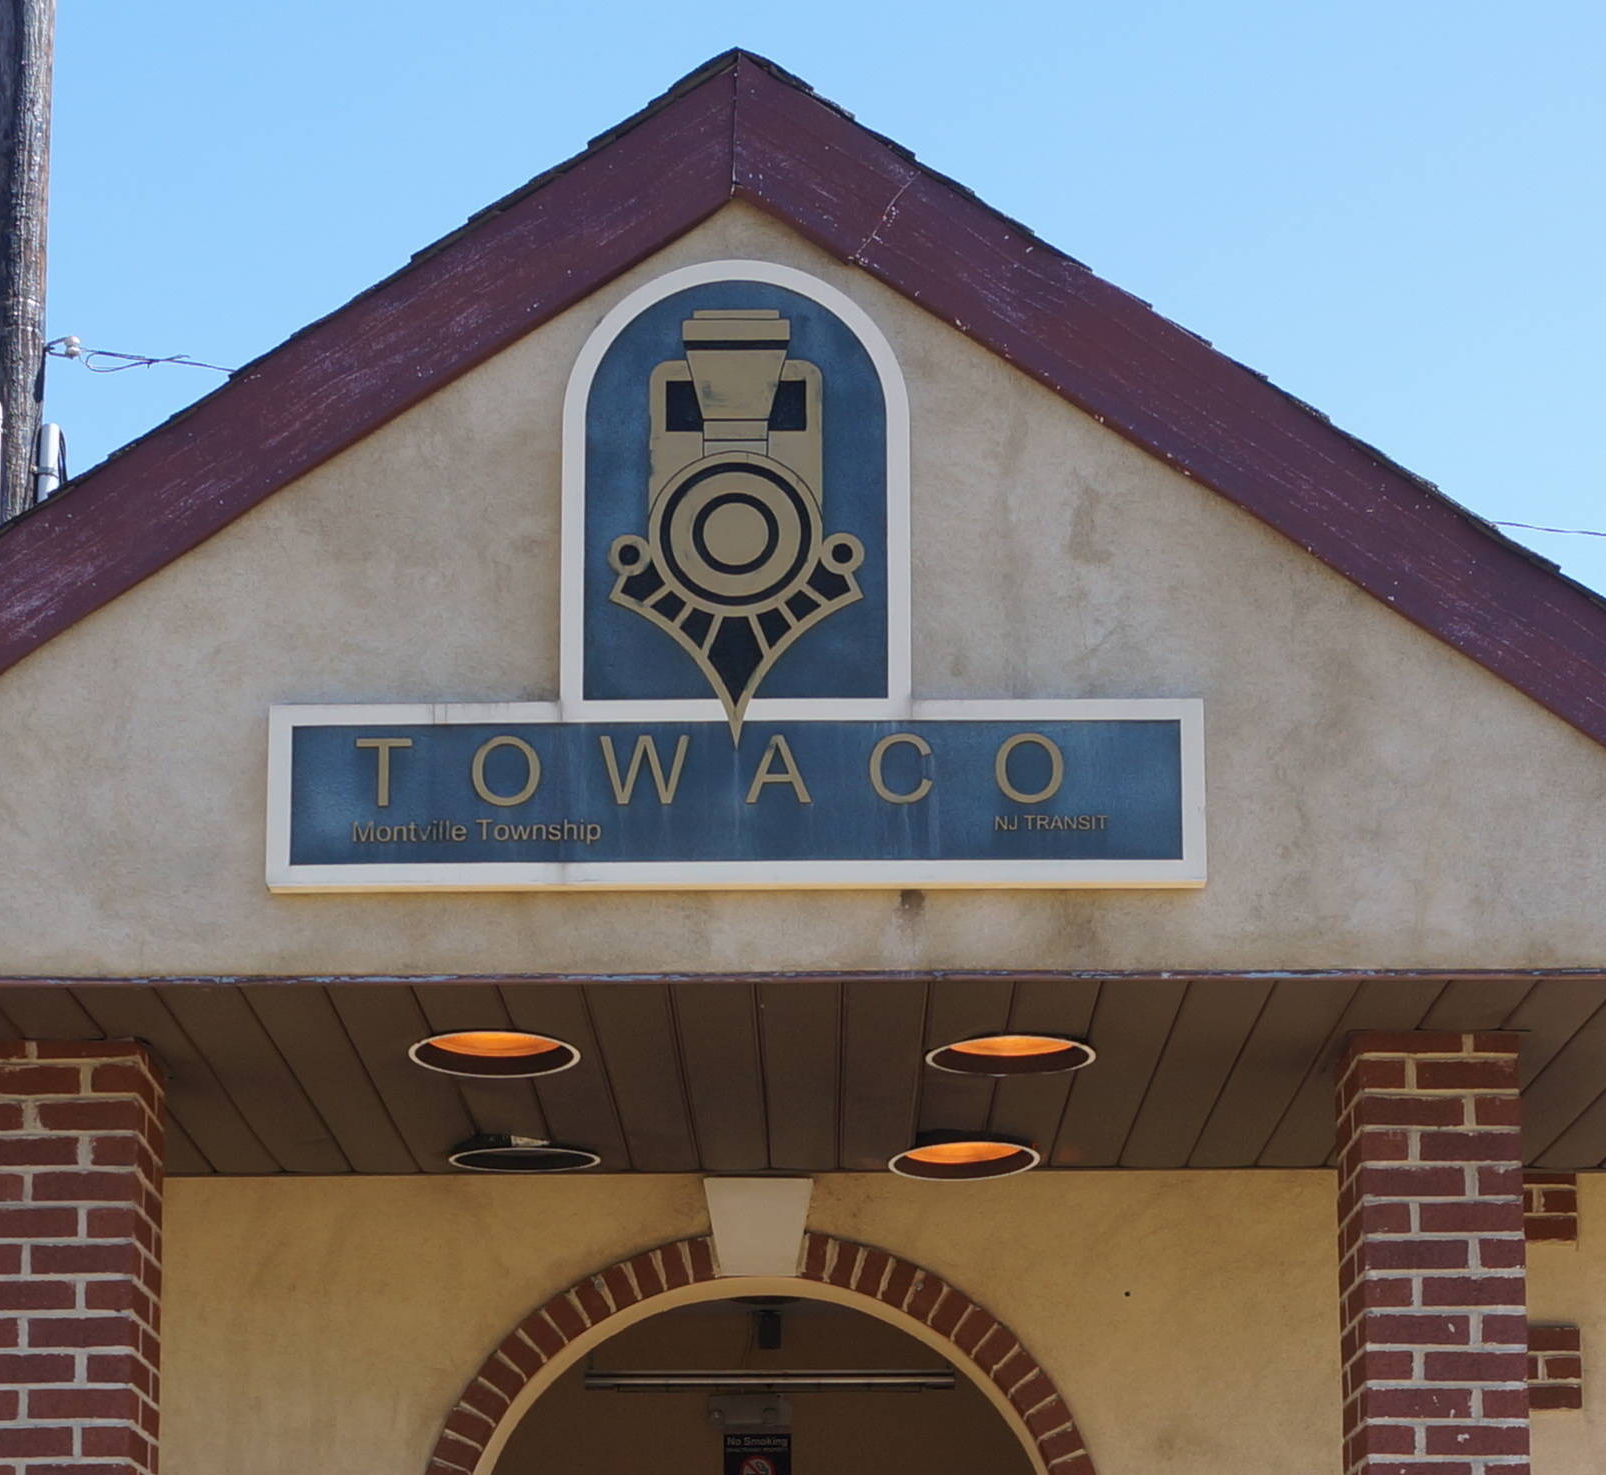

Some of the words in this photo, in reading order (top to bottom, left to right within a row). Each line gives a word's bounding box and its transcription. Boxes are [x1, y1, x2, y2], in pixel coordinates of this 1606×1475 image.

[355, 732, 1064, 806] TOWACO
[351, 820, 467, 843] Montville
[476, 818, 602, 845] Township
[994, 815, 1018, 830] NJ
[1024, 814, 1109, 830] TRANSIT
[727, 1437, 742, 1446] No
[744, 1437, 788, 1447] Smoking
